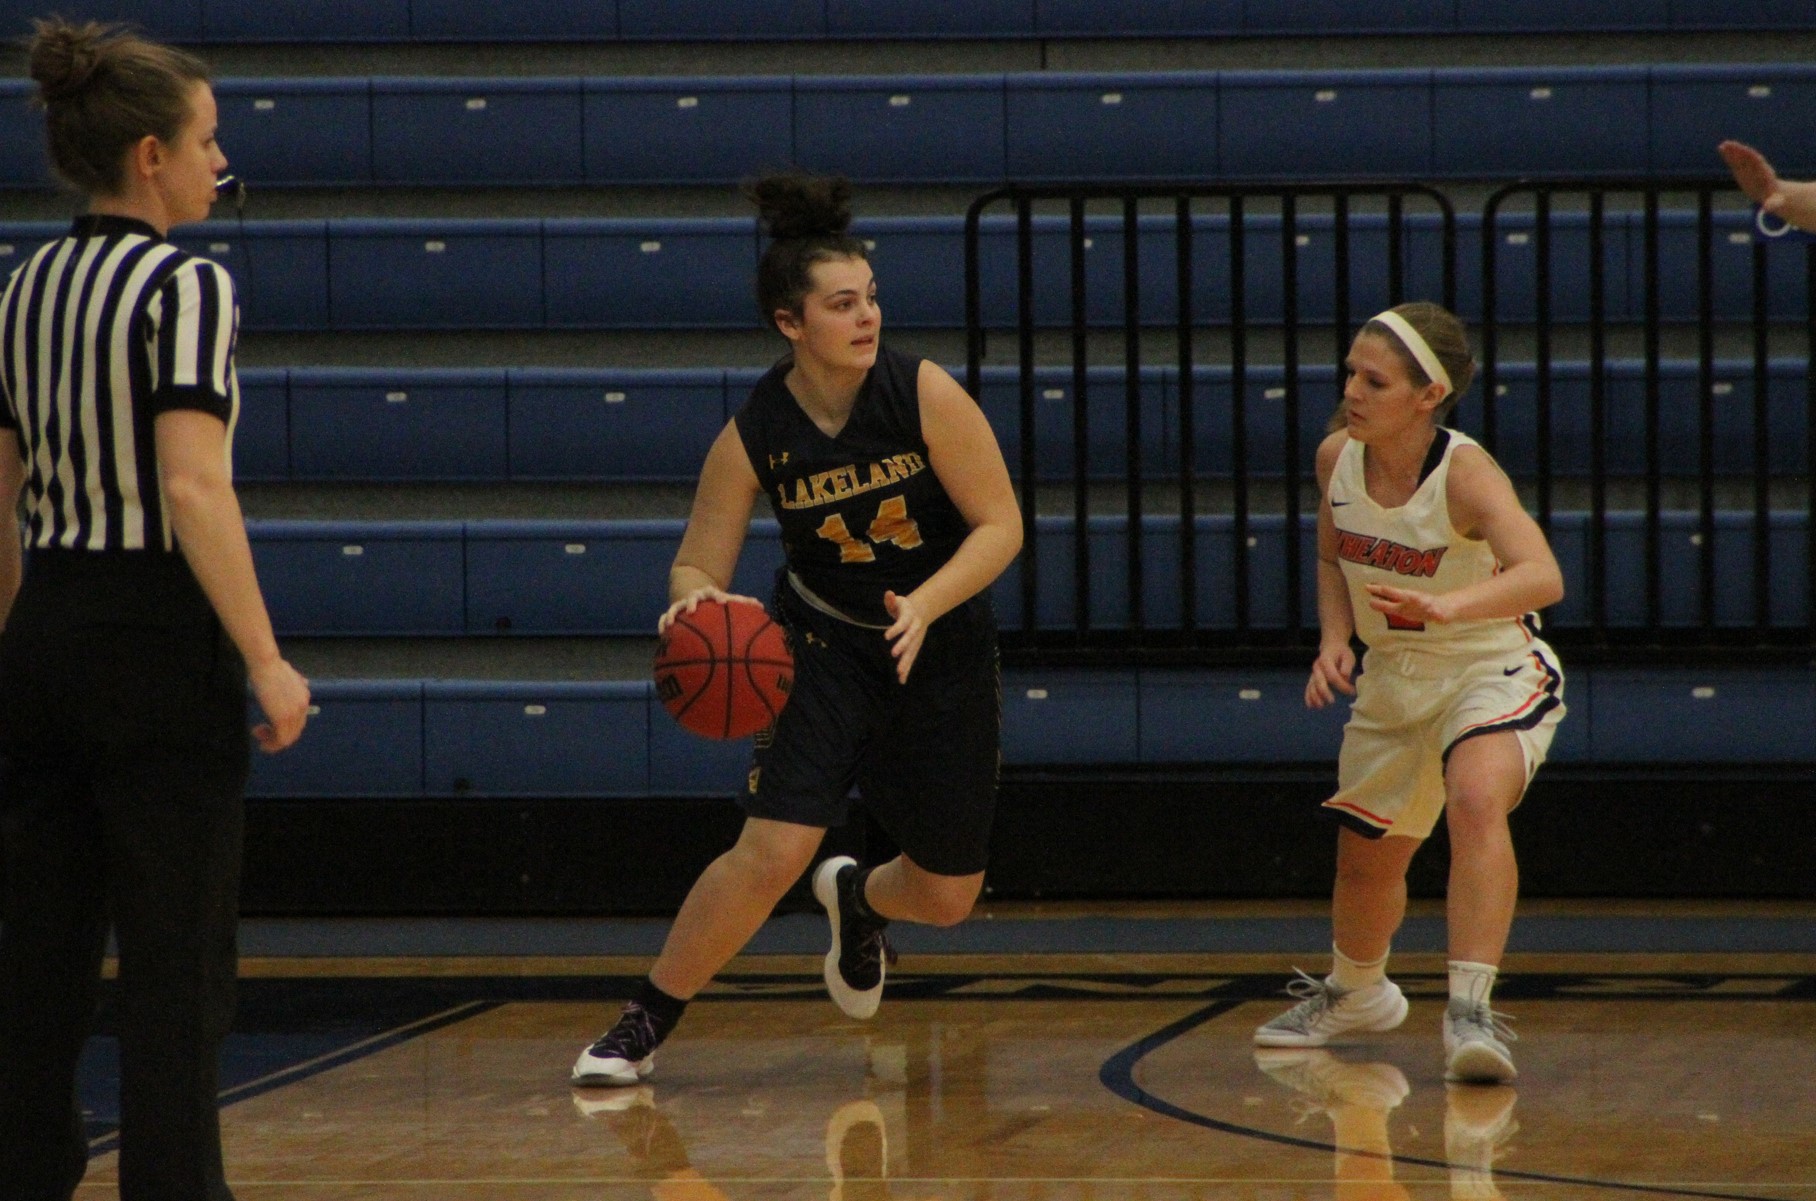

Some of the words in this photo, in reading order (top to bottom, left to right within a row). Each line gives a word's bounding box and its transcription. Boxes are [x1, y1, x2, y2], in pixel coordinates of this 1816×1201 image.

[778, 452, 926, 510] LAKELAND
[815, 495, 924, 564] 14
[1336, 528, 1449, 578] HEATON
